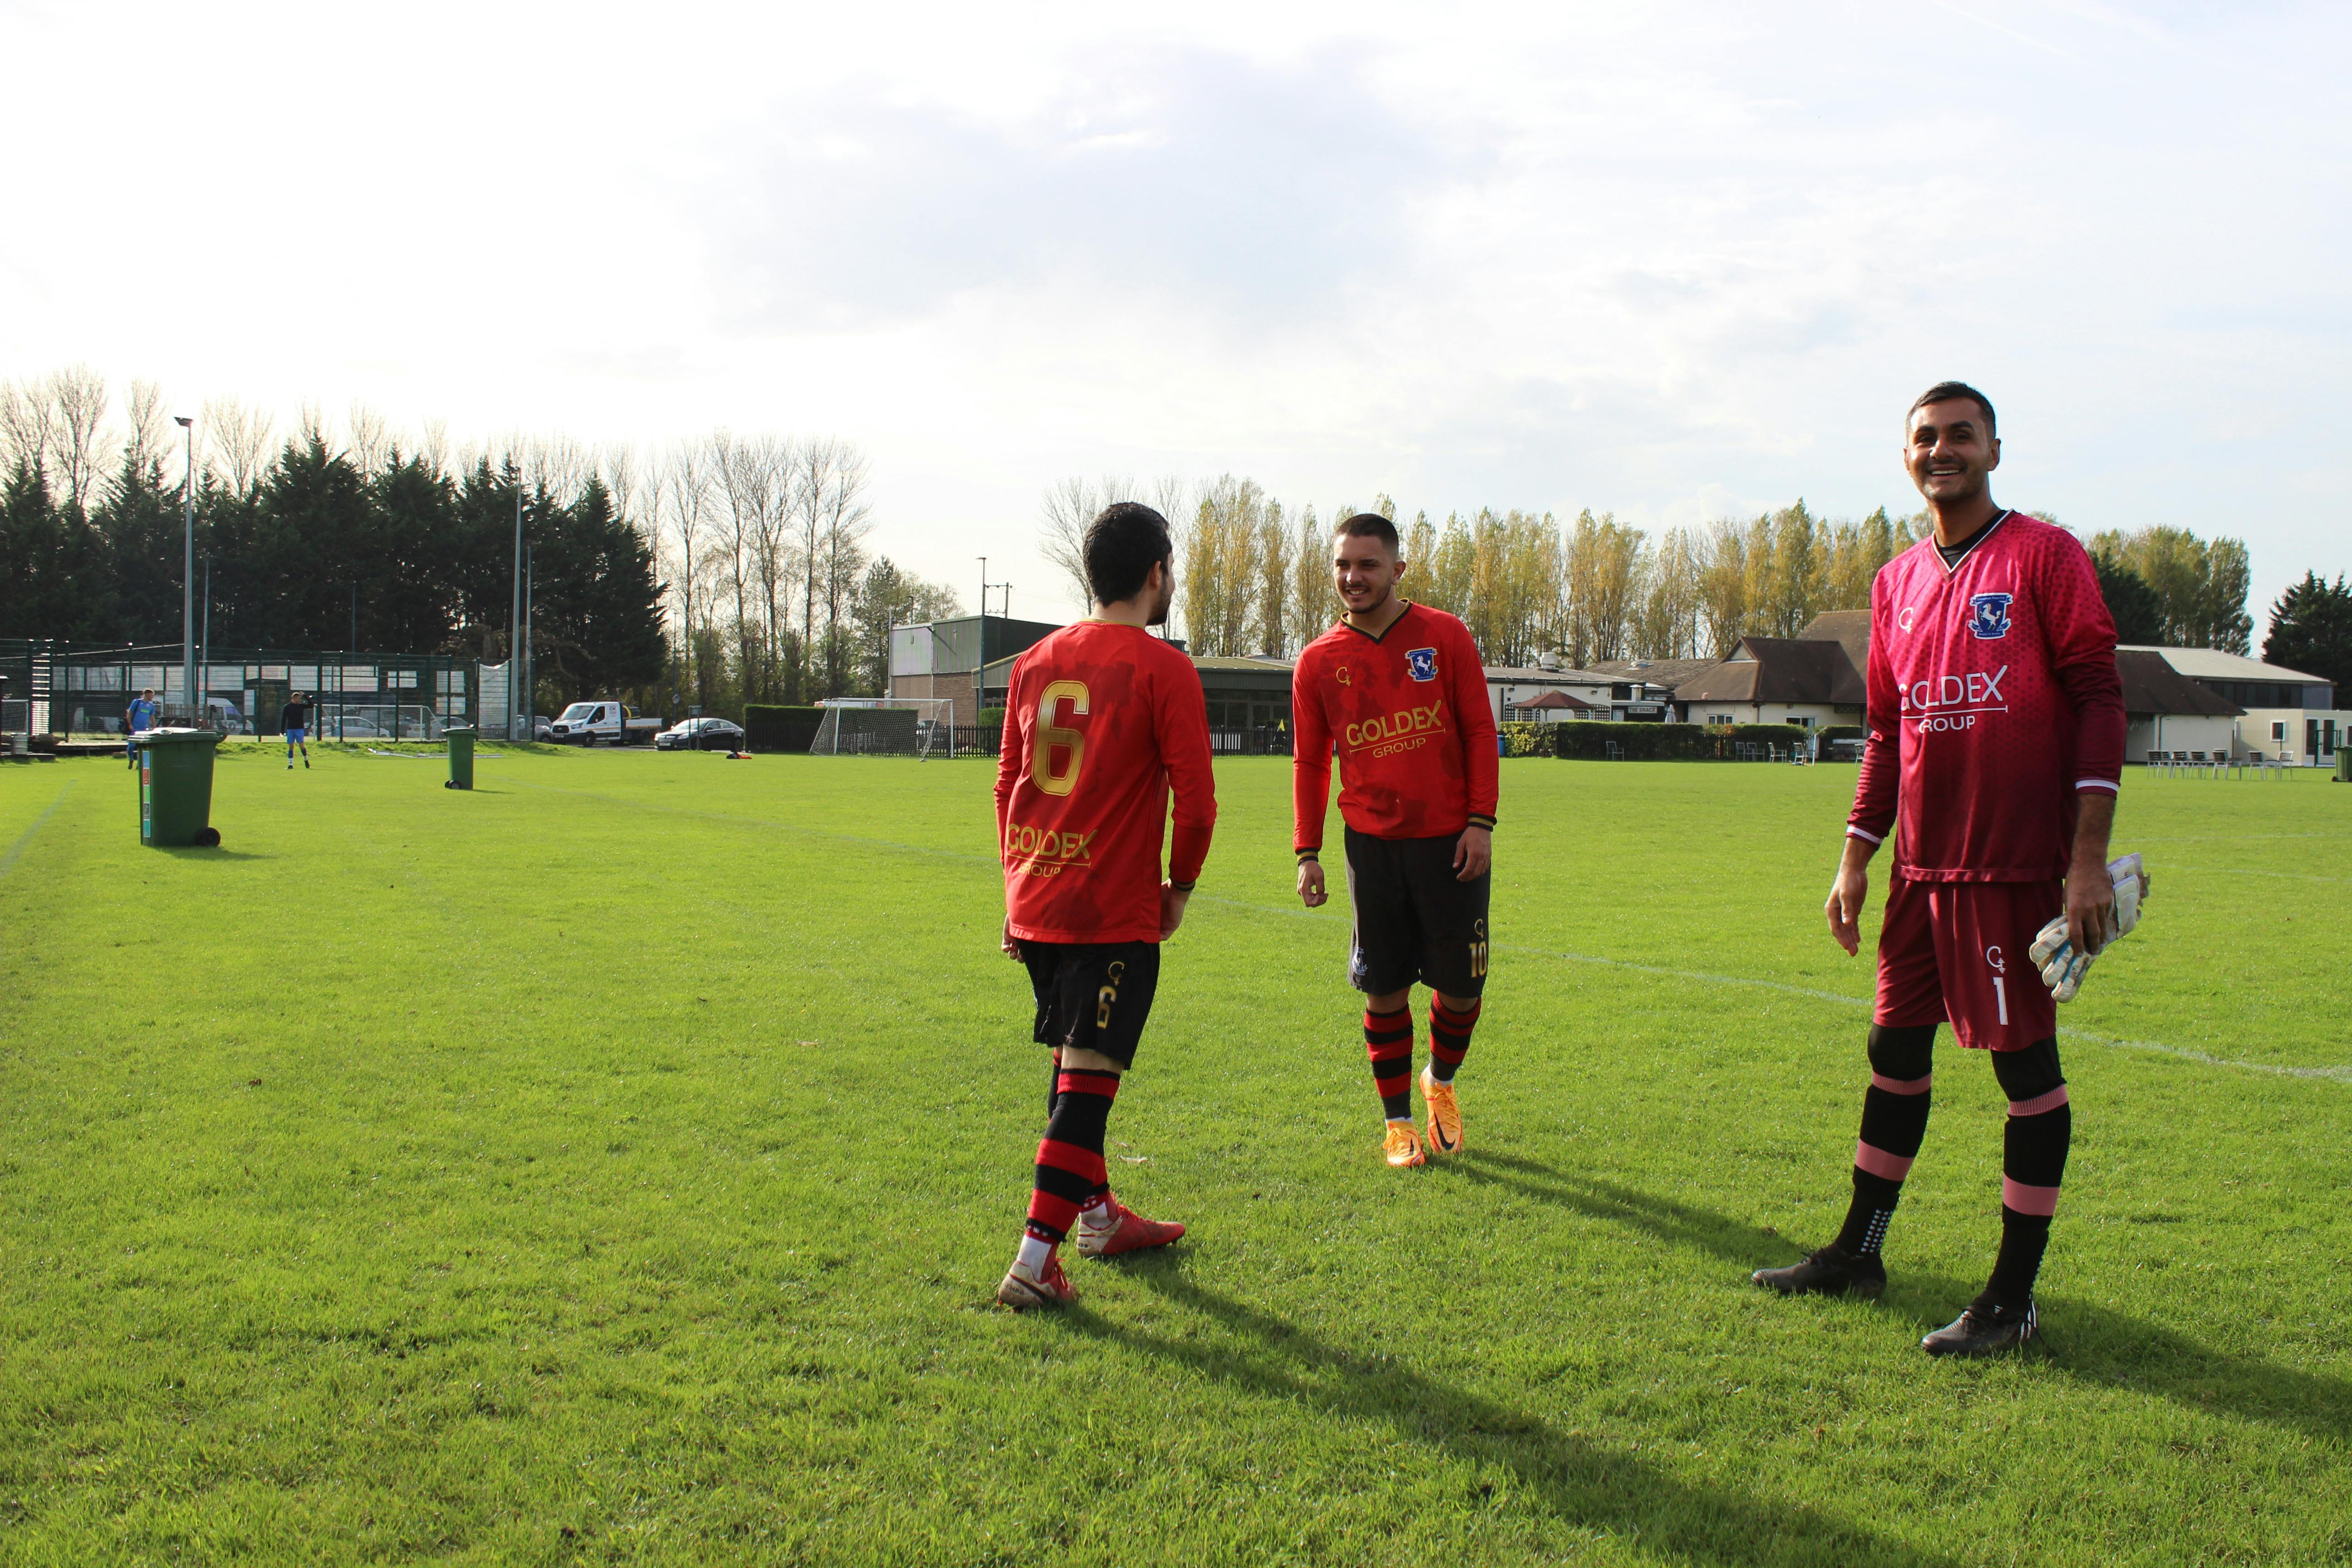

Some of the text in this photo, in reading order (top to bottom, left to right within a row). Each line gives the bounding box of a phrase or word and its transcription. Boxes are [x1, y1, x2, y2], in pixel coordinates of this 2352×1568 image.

[1031, 680, 1089, 796] 6
[1347, 700, 1442, 746] GOLDEX
[1919, 715, 1975, 734] GROUP
[1373, 737, 1426, 758] GROUP
[1008, 823, 1098, 859] GOLDEX
[1019, 862, 1061, 877] GROUP
[1469, 941, 1487, 977] 10
[1097, 985, 1117, 1029] 6
[1993, 977, 2008, 1025] 1
